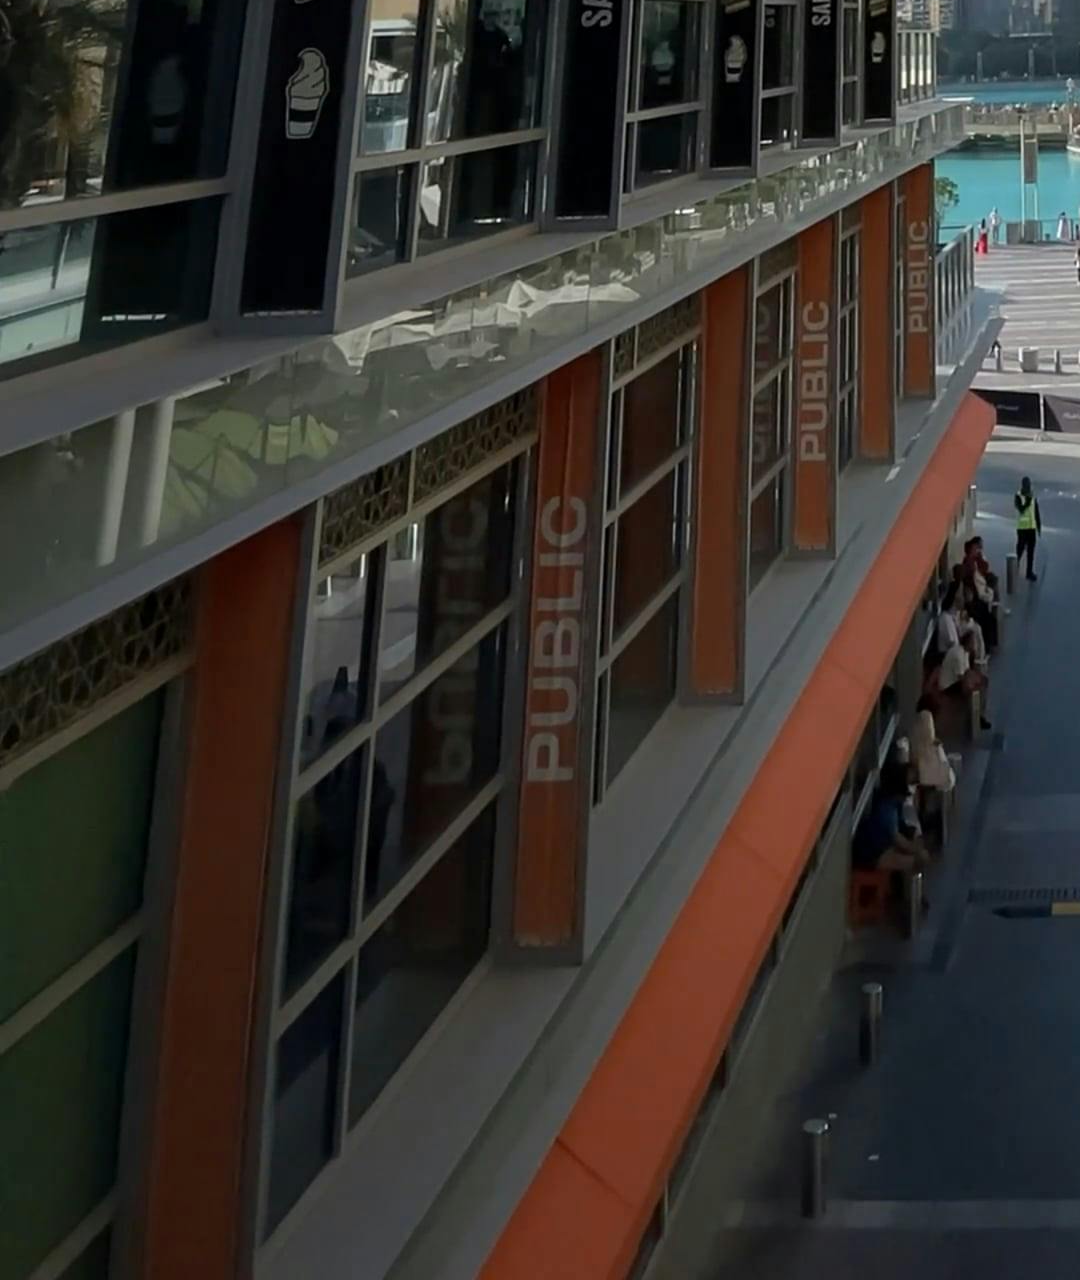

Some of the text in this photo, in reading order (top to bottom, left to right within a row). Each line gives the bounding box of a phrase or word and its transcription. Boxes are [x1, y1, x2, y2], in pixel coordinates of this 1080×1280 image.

[906, 220, 929, 334] PUBLIC
[800, 301, 830, 462] PUBLIC
[527, 495, 588, 782] PUBLIC
